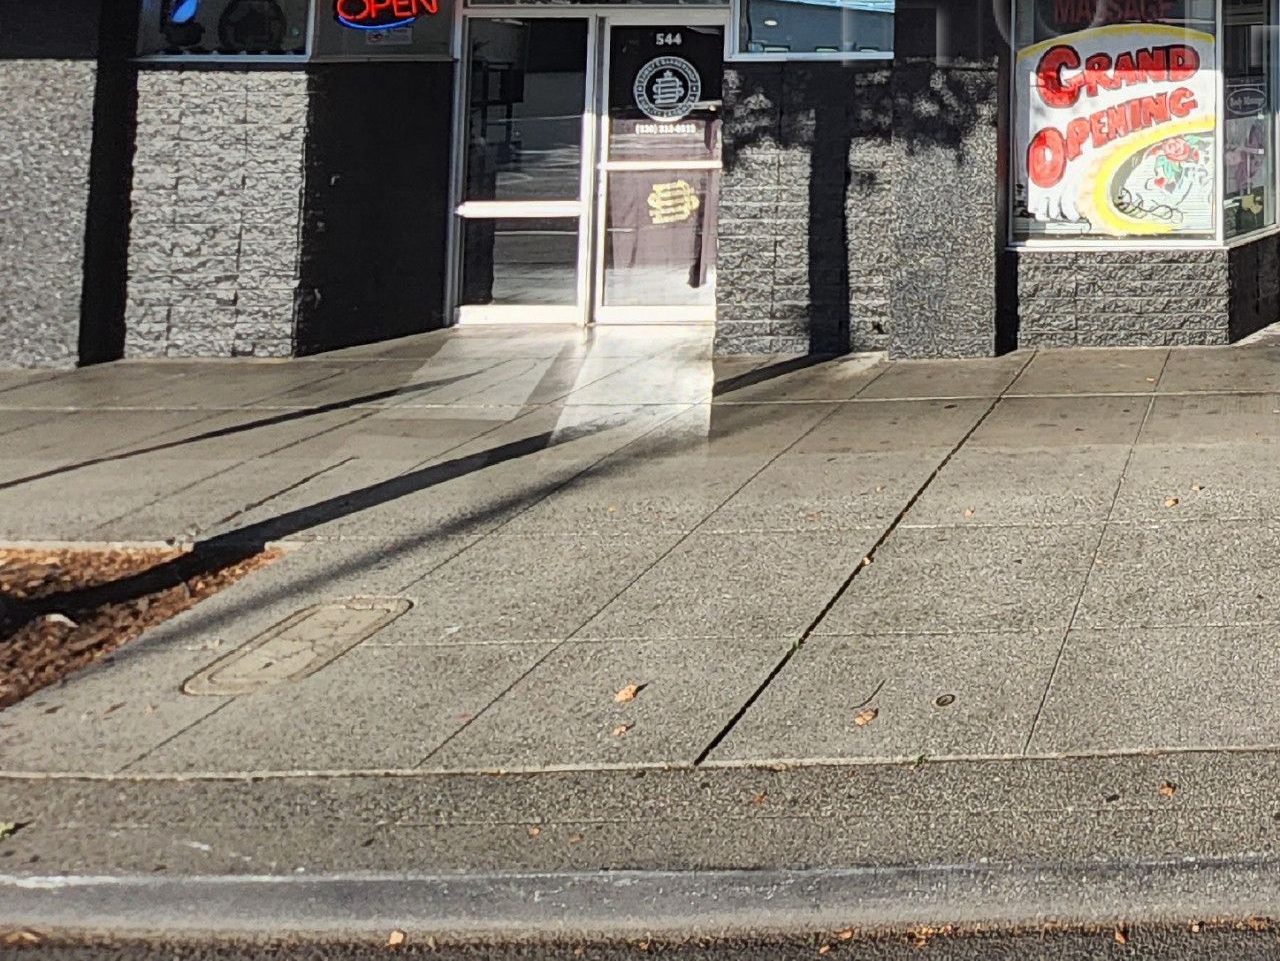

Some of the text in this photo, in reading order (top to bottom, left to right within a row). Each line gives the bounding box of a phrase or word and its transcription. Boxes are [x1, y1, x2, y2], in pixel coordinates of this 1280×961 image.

[656, 33, 682, 45] 544
[1036, 44, 1200, 109] GRAND
[1027, 87, 1199, 188] OPENING
